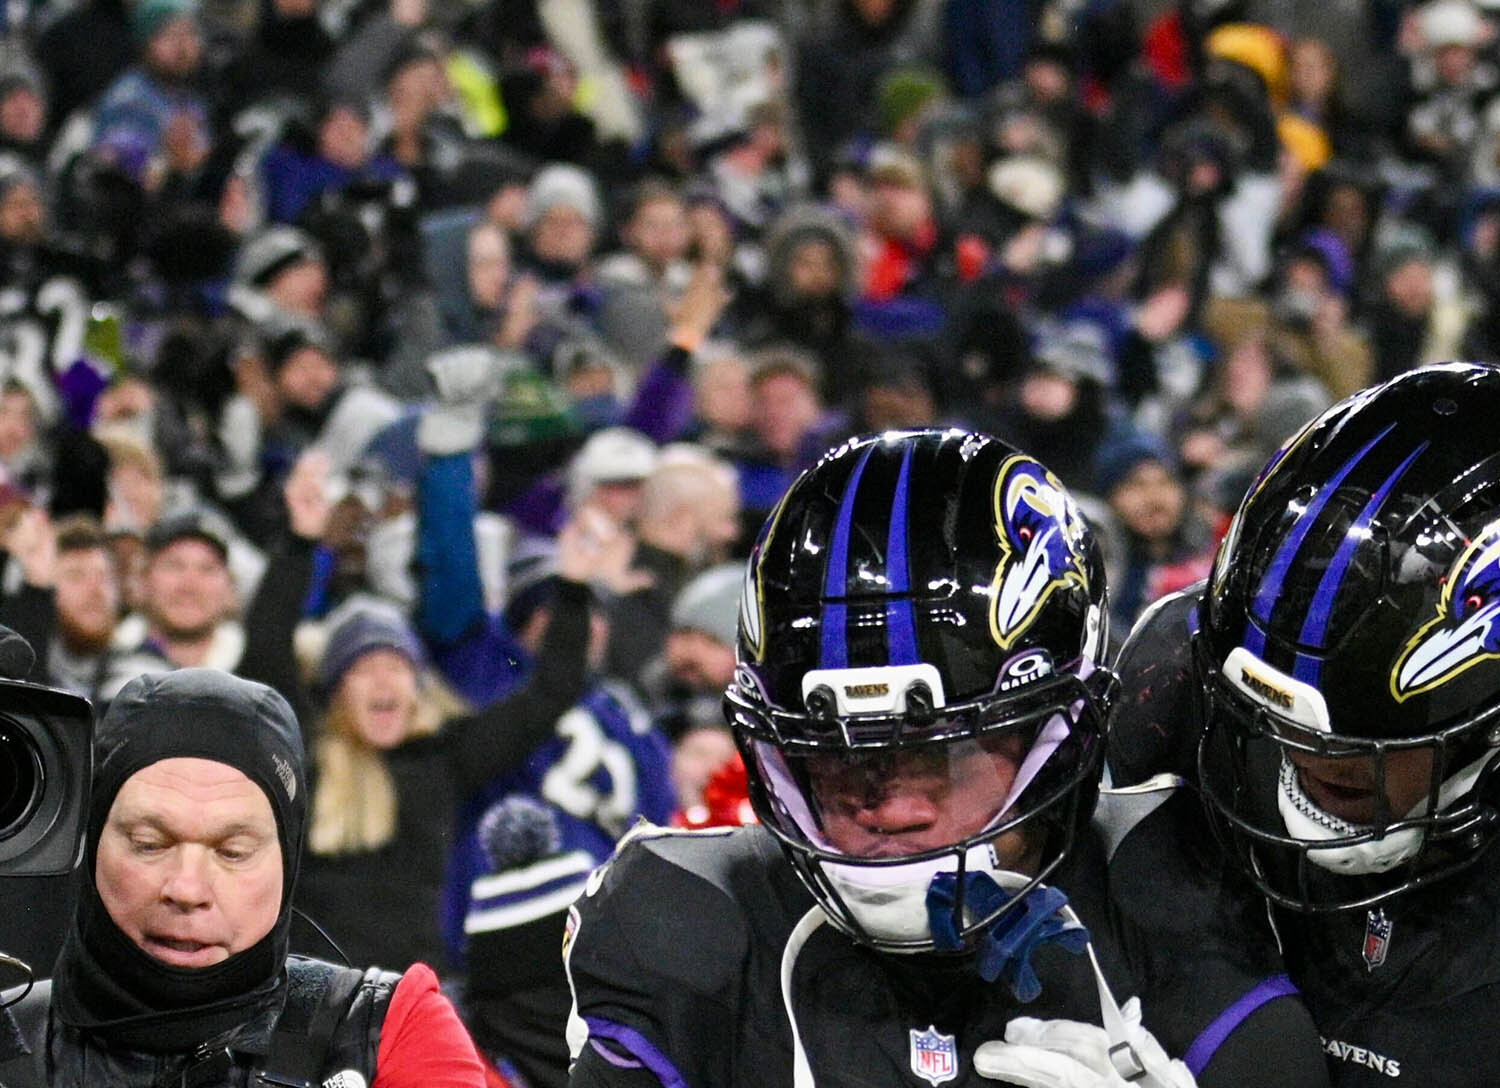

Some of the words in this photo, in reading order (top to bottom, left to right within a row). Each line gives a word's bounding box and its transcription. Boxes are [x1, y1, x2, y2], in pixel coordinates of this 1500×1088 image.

[844, 683, 889, 698] RAVENS
[919, 1050, 951, 1073] NFL
[1320, 1036, 1400, 1078] AVENS
